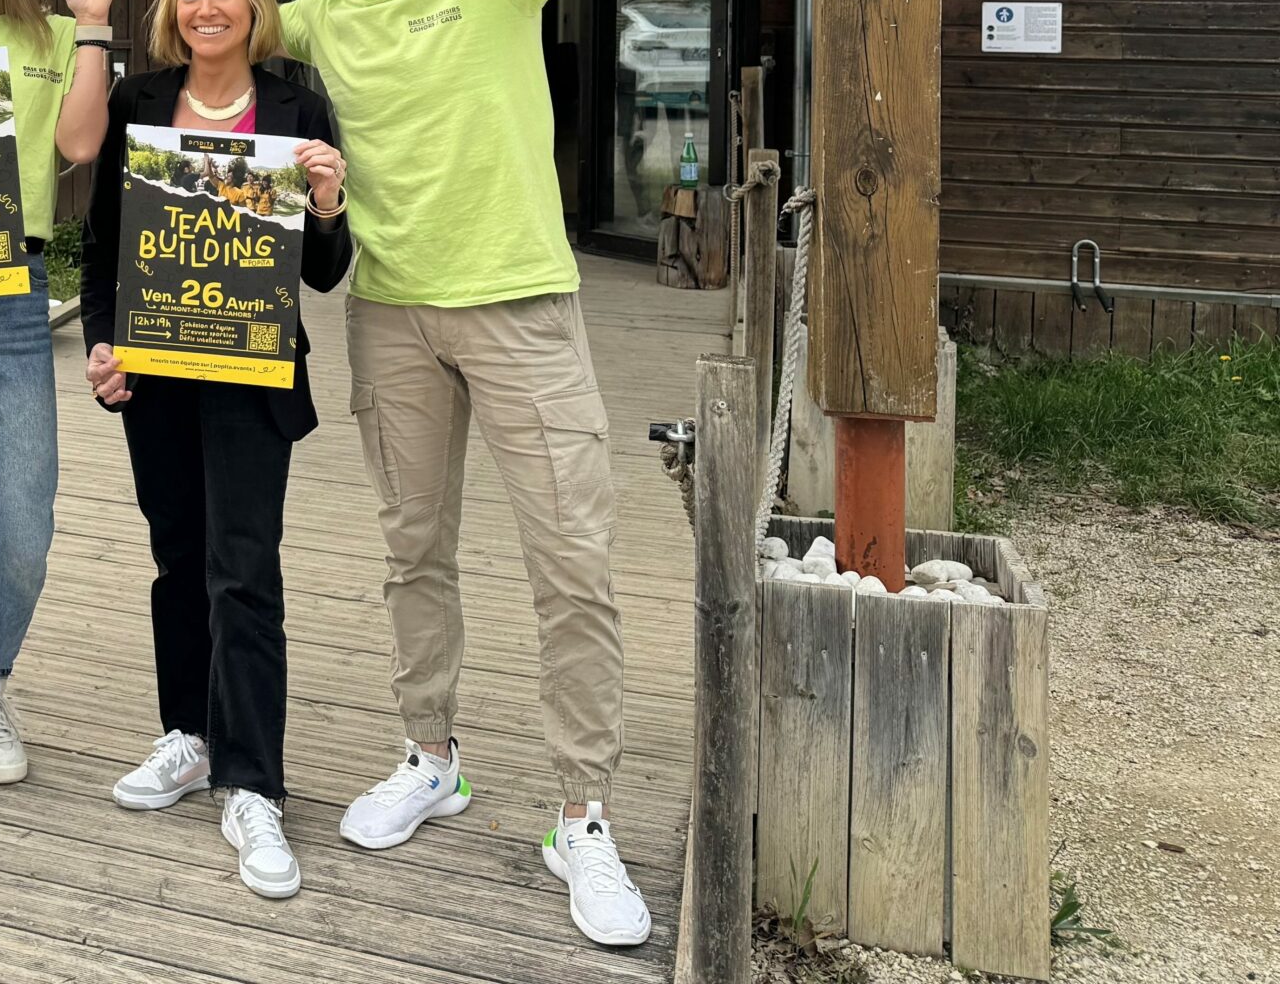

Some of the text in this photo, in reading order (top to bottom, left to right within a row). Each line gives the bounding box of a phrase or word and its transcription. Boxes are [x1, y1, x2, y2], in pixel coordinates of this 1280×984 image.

[436, 6, 461, 18] LOISIRS
[441, 14, 462, 23] CATUS
[164, 207, 240, 239] TEAM
[139, 229, 275, 267] BUILDING
[141, 279, 264, 312] Ven. 26 Avril
